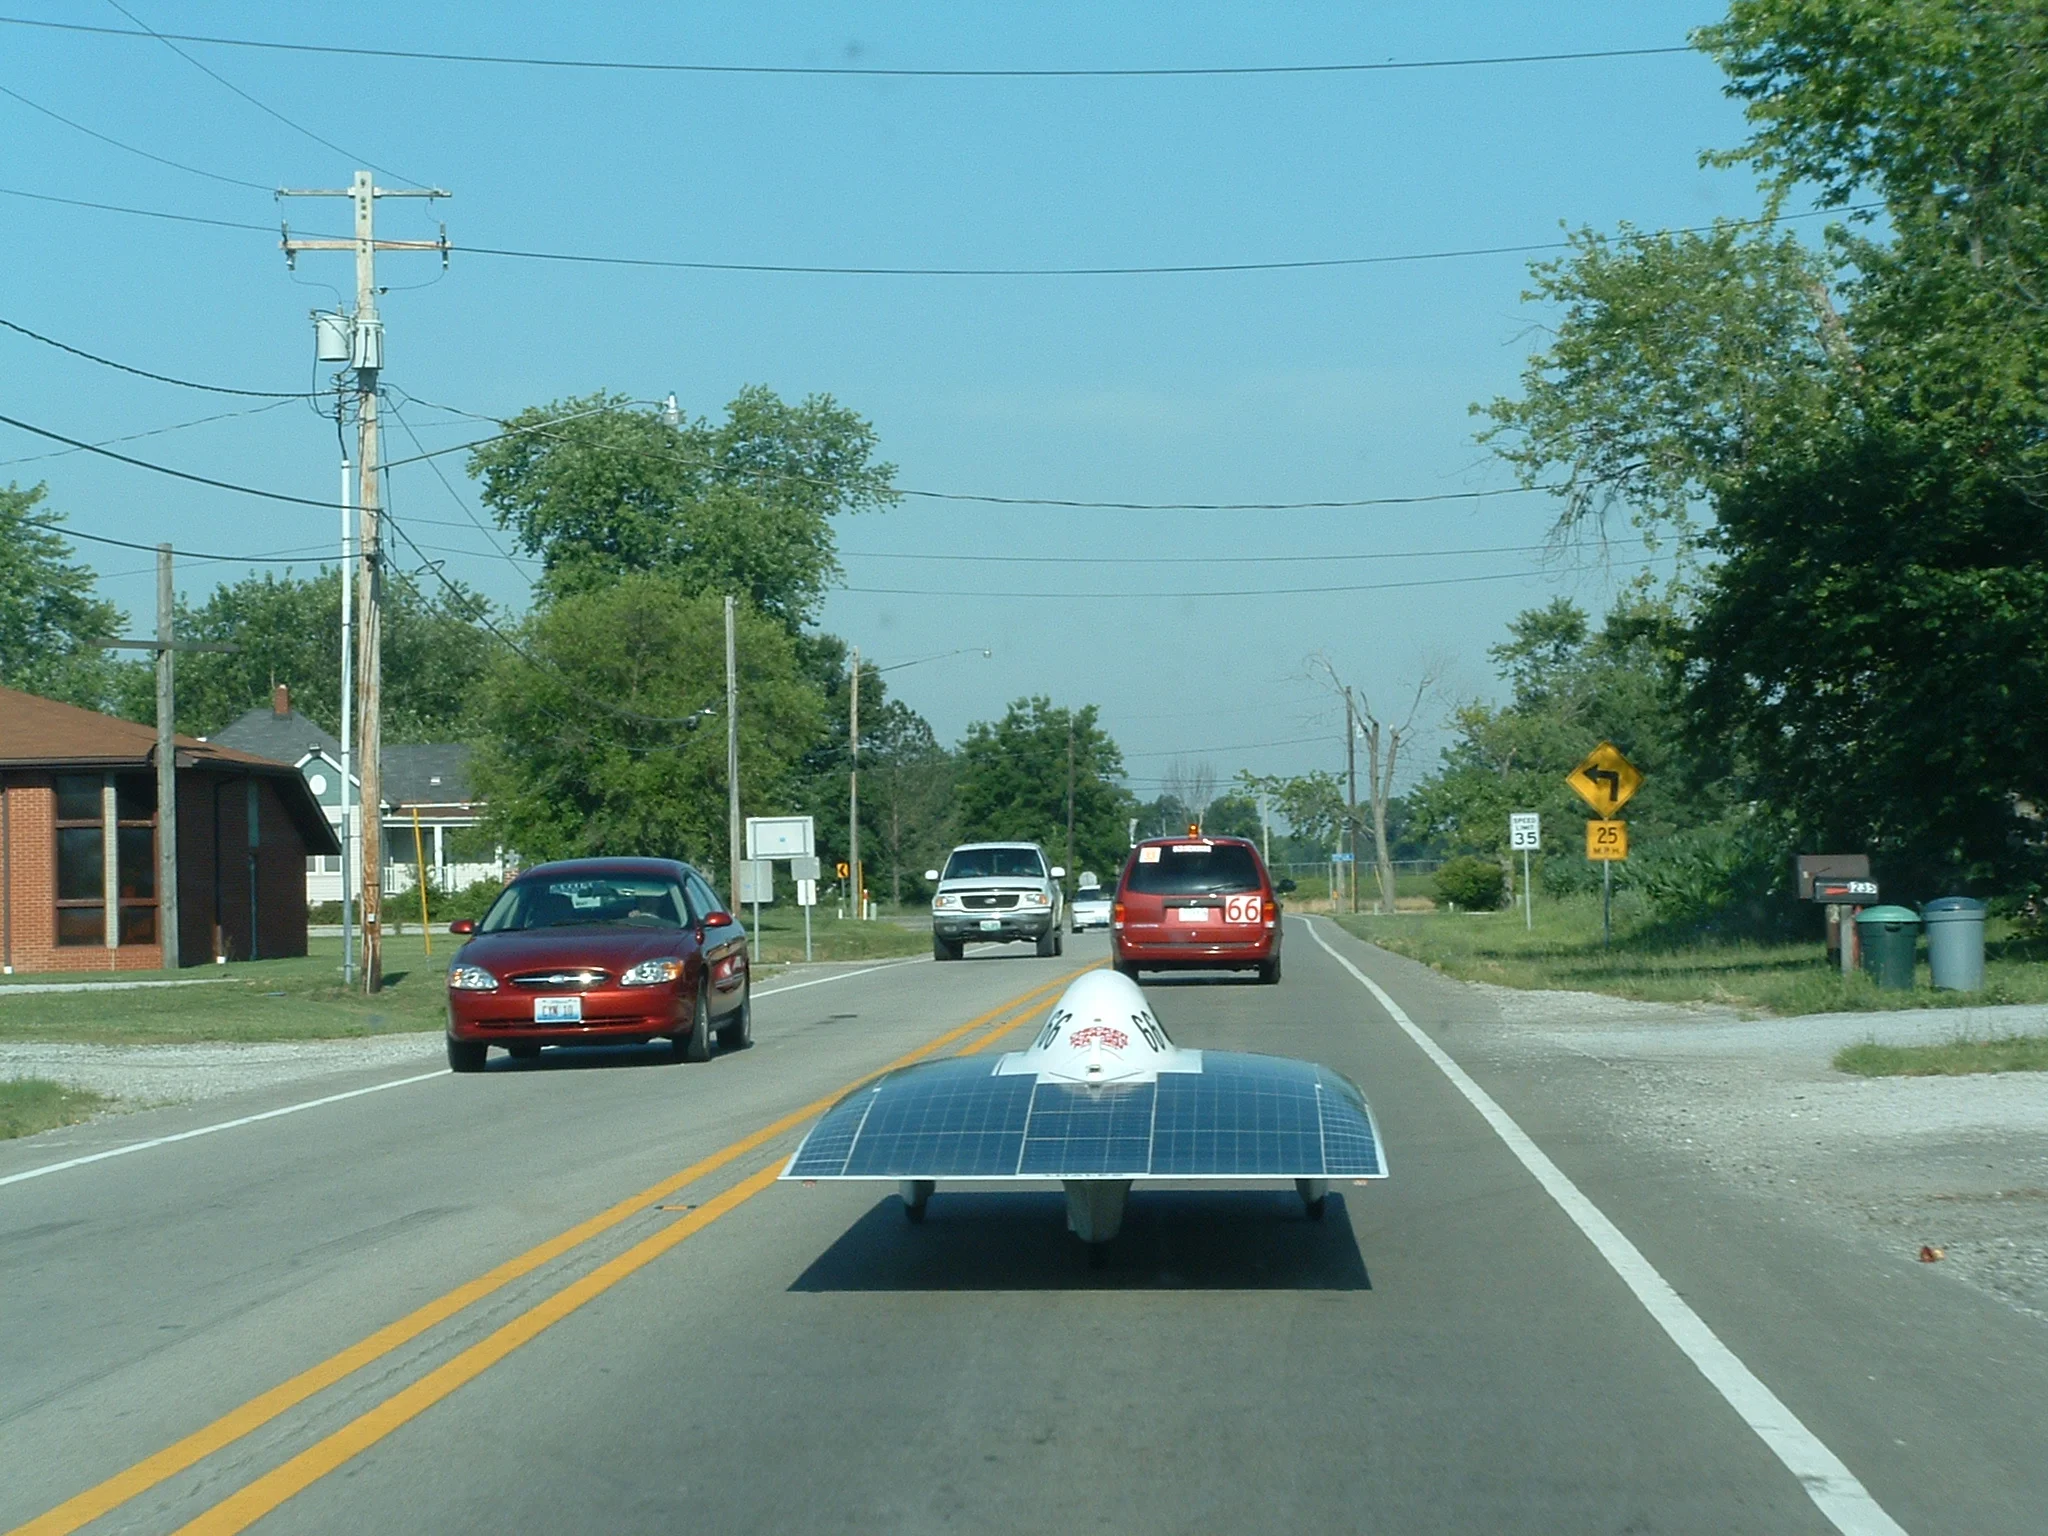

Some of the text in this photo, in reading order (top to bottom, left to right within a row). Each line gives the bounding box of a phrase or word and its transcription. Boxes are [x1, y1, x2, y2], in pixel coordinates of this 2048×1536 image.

[1514, 816, 1536, 824] SPEED
[1515, 832, 1537, 845] 35
[1597, 827, 1618, 844] 25
[1228, 898, 1259, 921] 66
[1038, 1009, 1073, 1050] 66
[1131, 1010, 1166, 1053] 66
